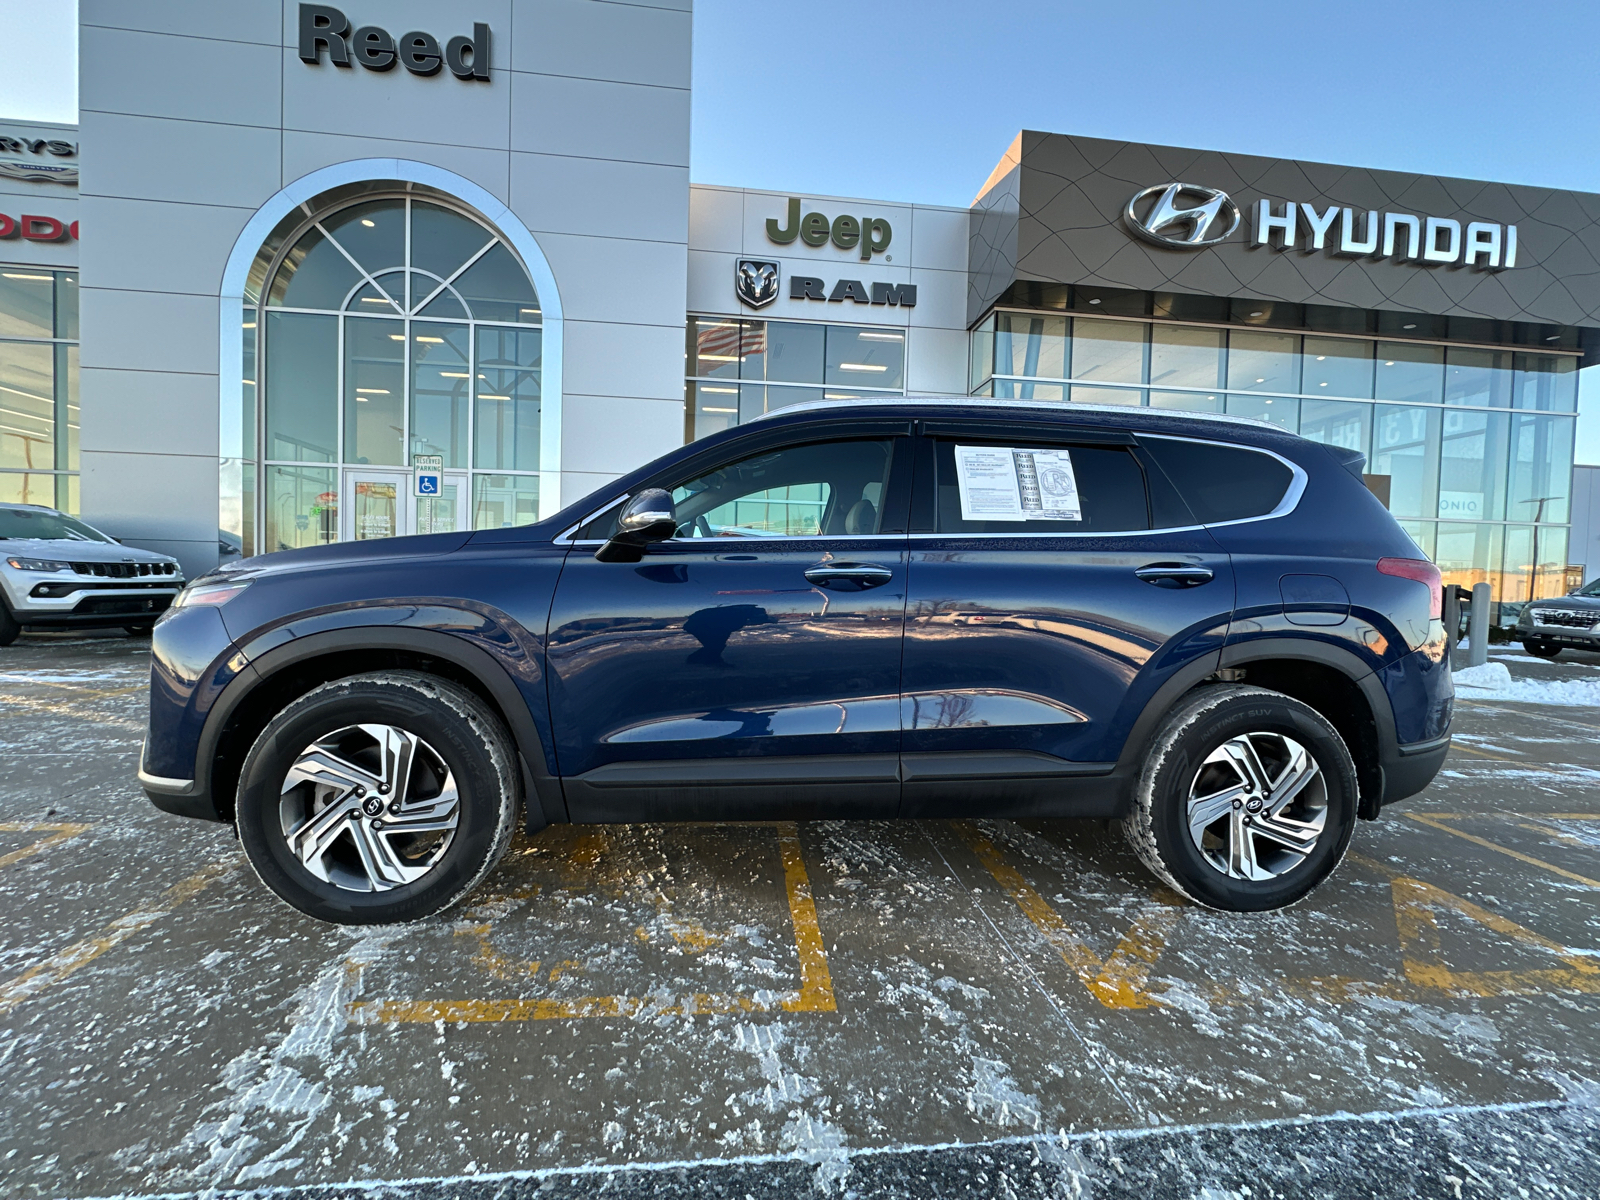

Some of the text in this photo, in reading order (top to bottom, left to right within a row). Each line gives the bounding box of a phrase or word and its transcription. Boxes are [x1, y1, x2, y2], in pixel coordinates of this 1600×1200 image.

[299, 2, 490, 82] Reed
[765, 197, 893, 260] Jeep
[1253, 198, 1518, 271] HYUNDAI
[790, 275, 918, 307] RAM
[416, 457, 441, 465] RESERVED
[416, 464, 441, 472] PARKING
[1440, 499, 1477, 512] ONIQ
[1248, 709, 1272, 718] SUV
